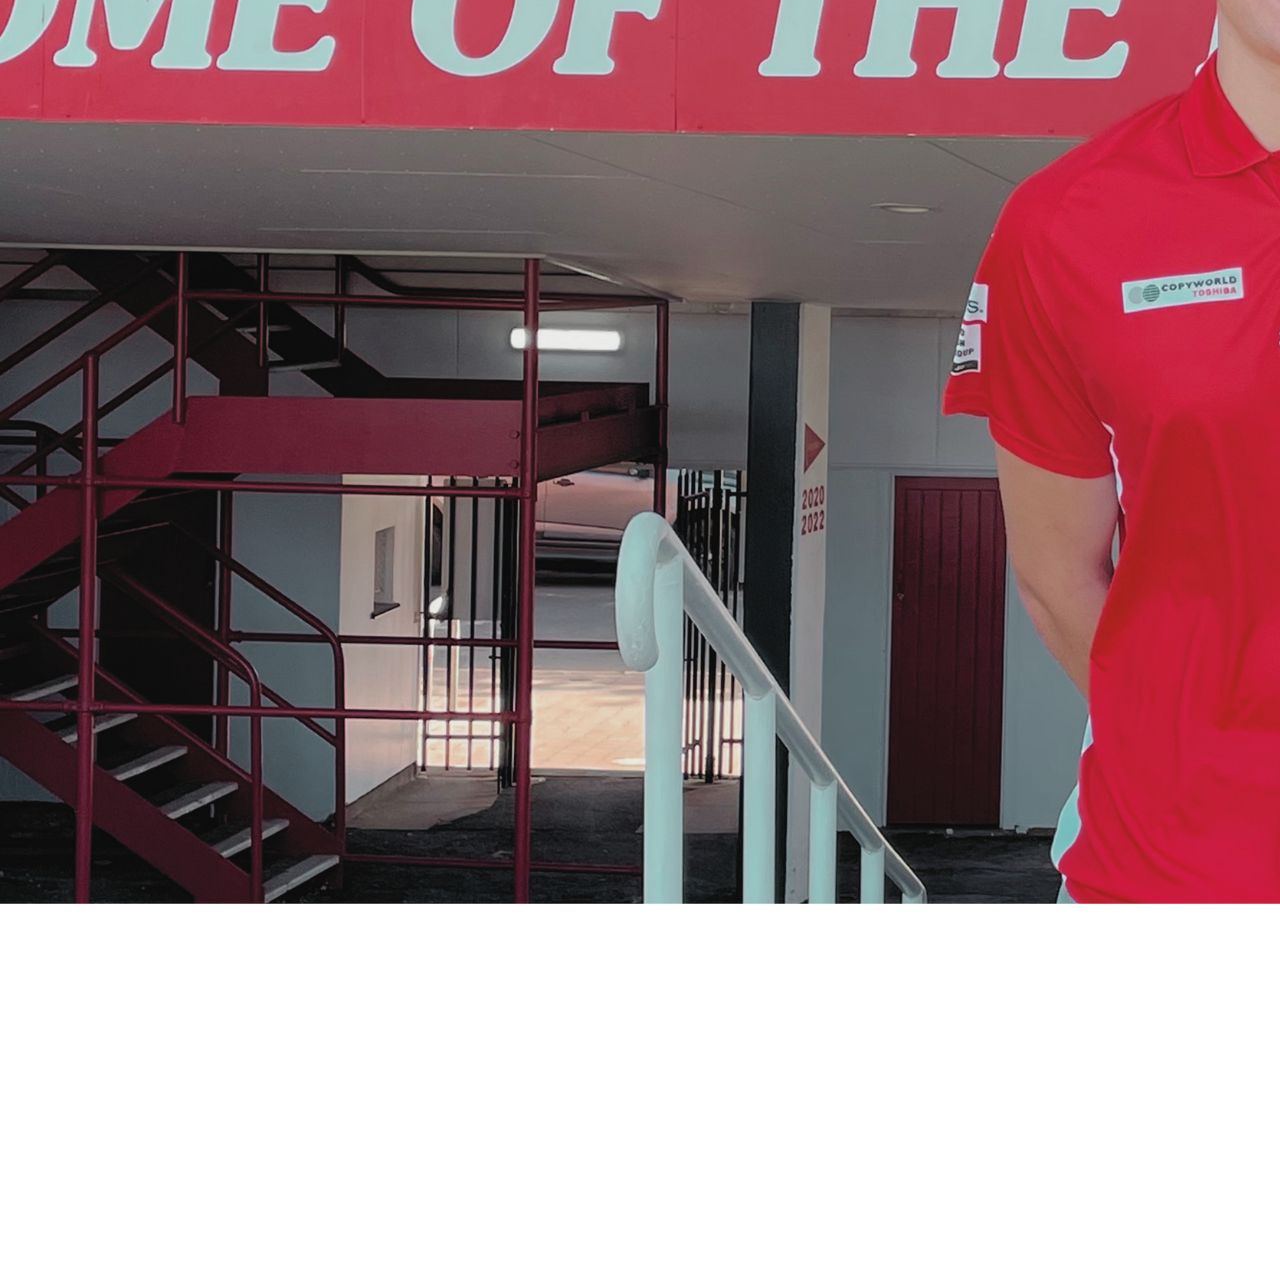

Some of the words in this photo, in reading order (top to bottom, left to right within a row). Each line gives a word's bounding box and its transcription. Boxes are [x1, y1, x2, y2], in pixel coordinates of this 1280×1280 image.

[1161, 275, 1238, 293] COPYWORLD
[1192, 286, 1238, 298] TOSHIBA
[801, 485, 825, 510] 2020
[801, 510, 825, 536] 2022
